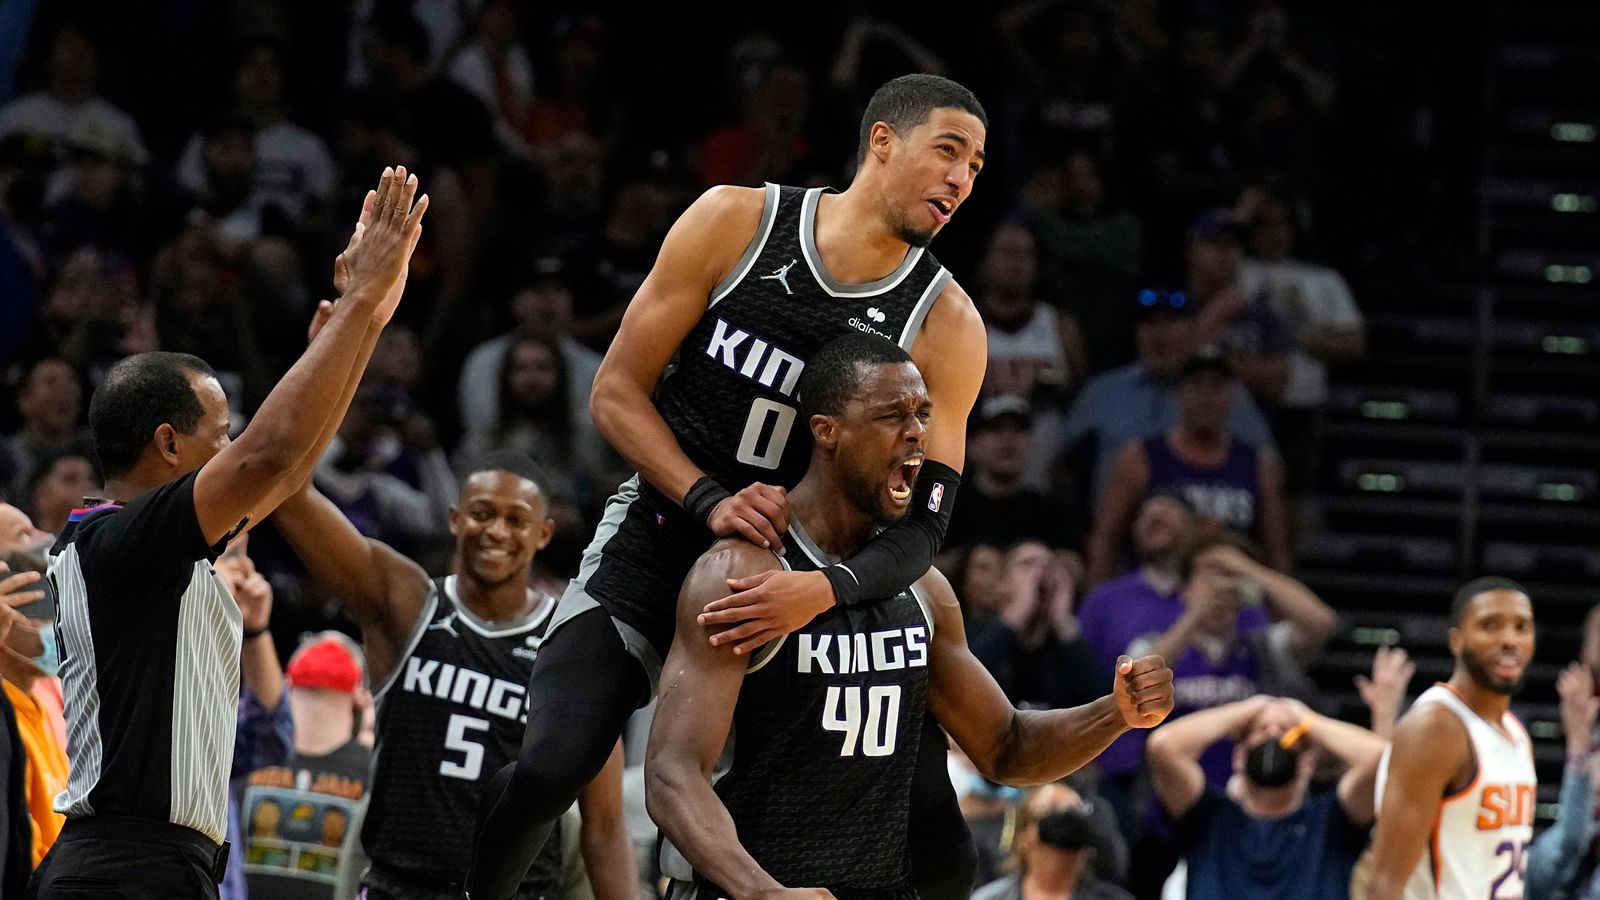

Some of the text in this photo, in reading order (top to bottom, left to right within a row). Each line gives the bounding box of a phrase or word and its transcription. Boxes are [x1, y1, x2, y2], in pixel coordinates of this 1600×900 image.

[706, 318, 804, 402] KIN
[736, 397, 797, 470] 0
[797, 626, 928, 674] KINGS
[439, 713, 490, 782] 5
[822, 685, 901, 757] 40
[1476, 784, 1537, 831] SUN
